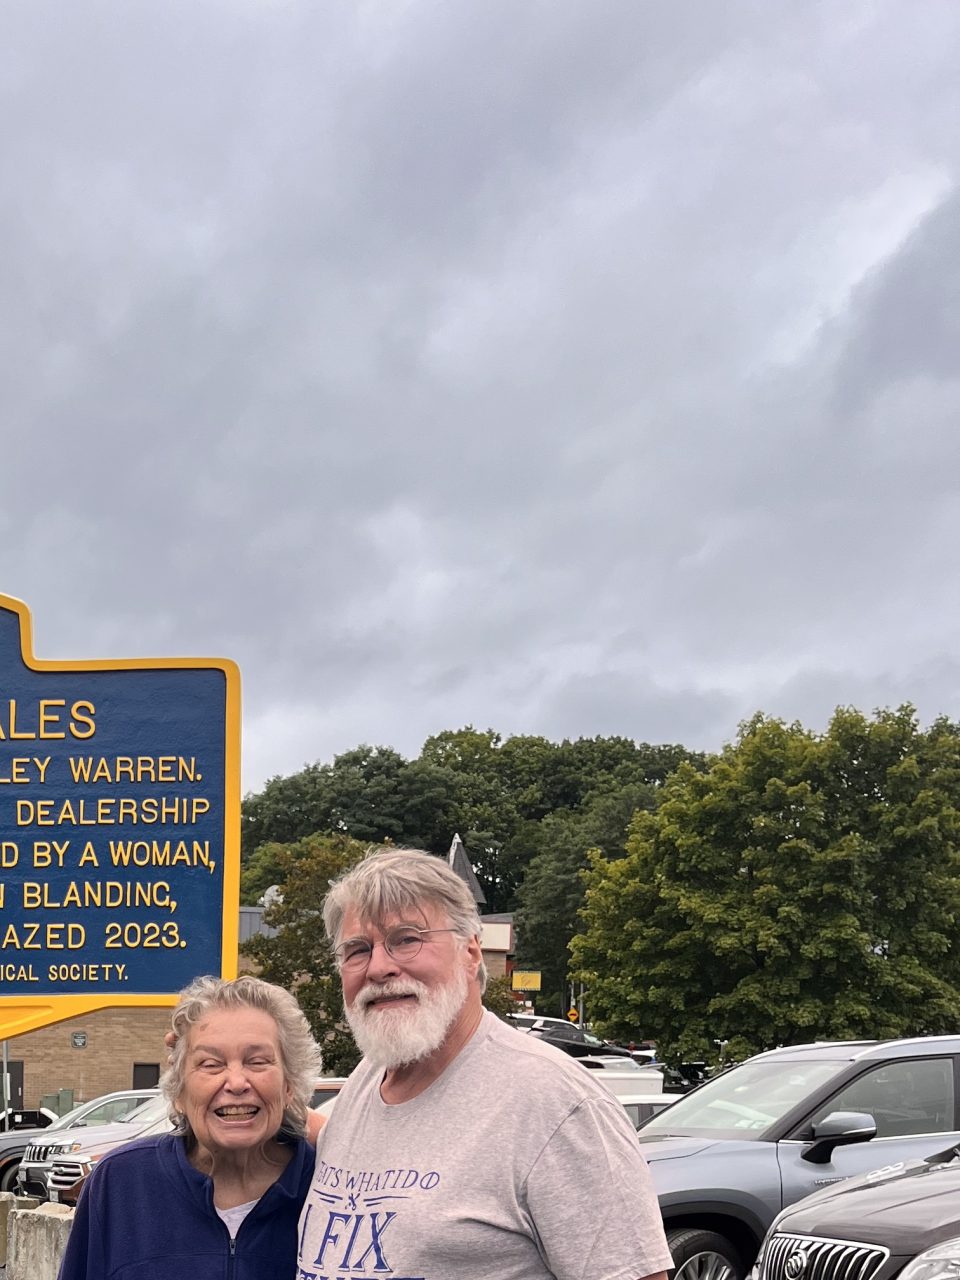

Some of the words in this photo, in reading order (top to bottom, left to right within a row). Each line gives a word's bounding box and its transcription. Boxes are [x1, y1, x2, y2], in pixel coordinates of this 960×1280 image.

[69, 756, 203, 783] WARREN.
[16, 798, 210, 826] DEALERSHIP
[33, 841, 70, 867] BY
[79, 841, 99, 867] A
[109, 840, 217, 873] WOMAN,
[23, 882, 178, 914] BLANDING,
[104, 922, 188, 949] 2023.
[48, 964, 129, 982] SOCIETY.
[313, 1211, 397, 1273] FIX
